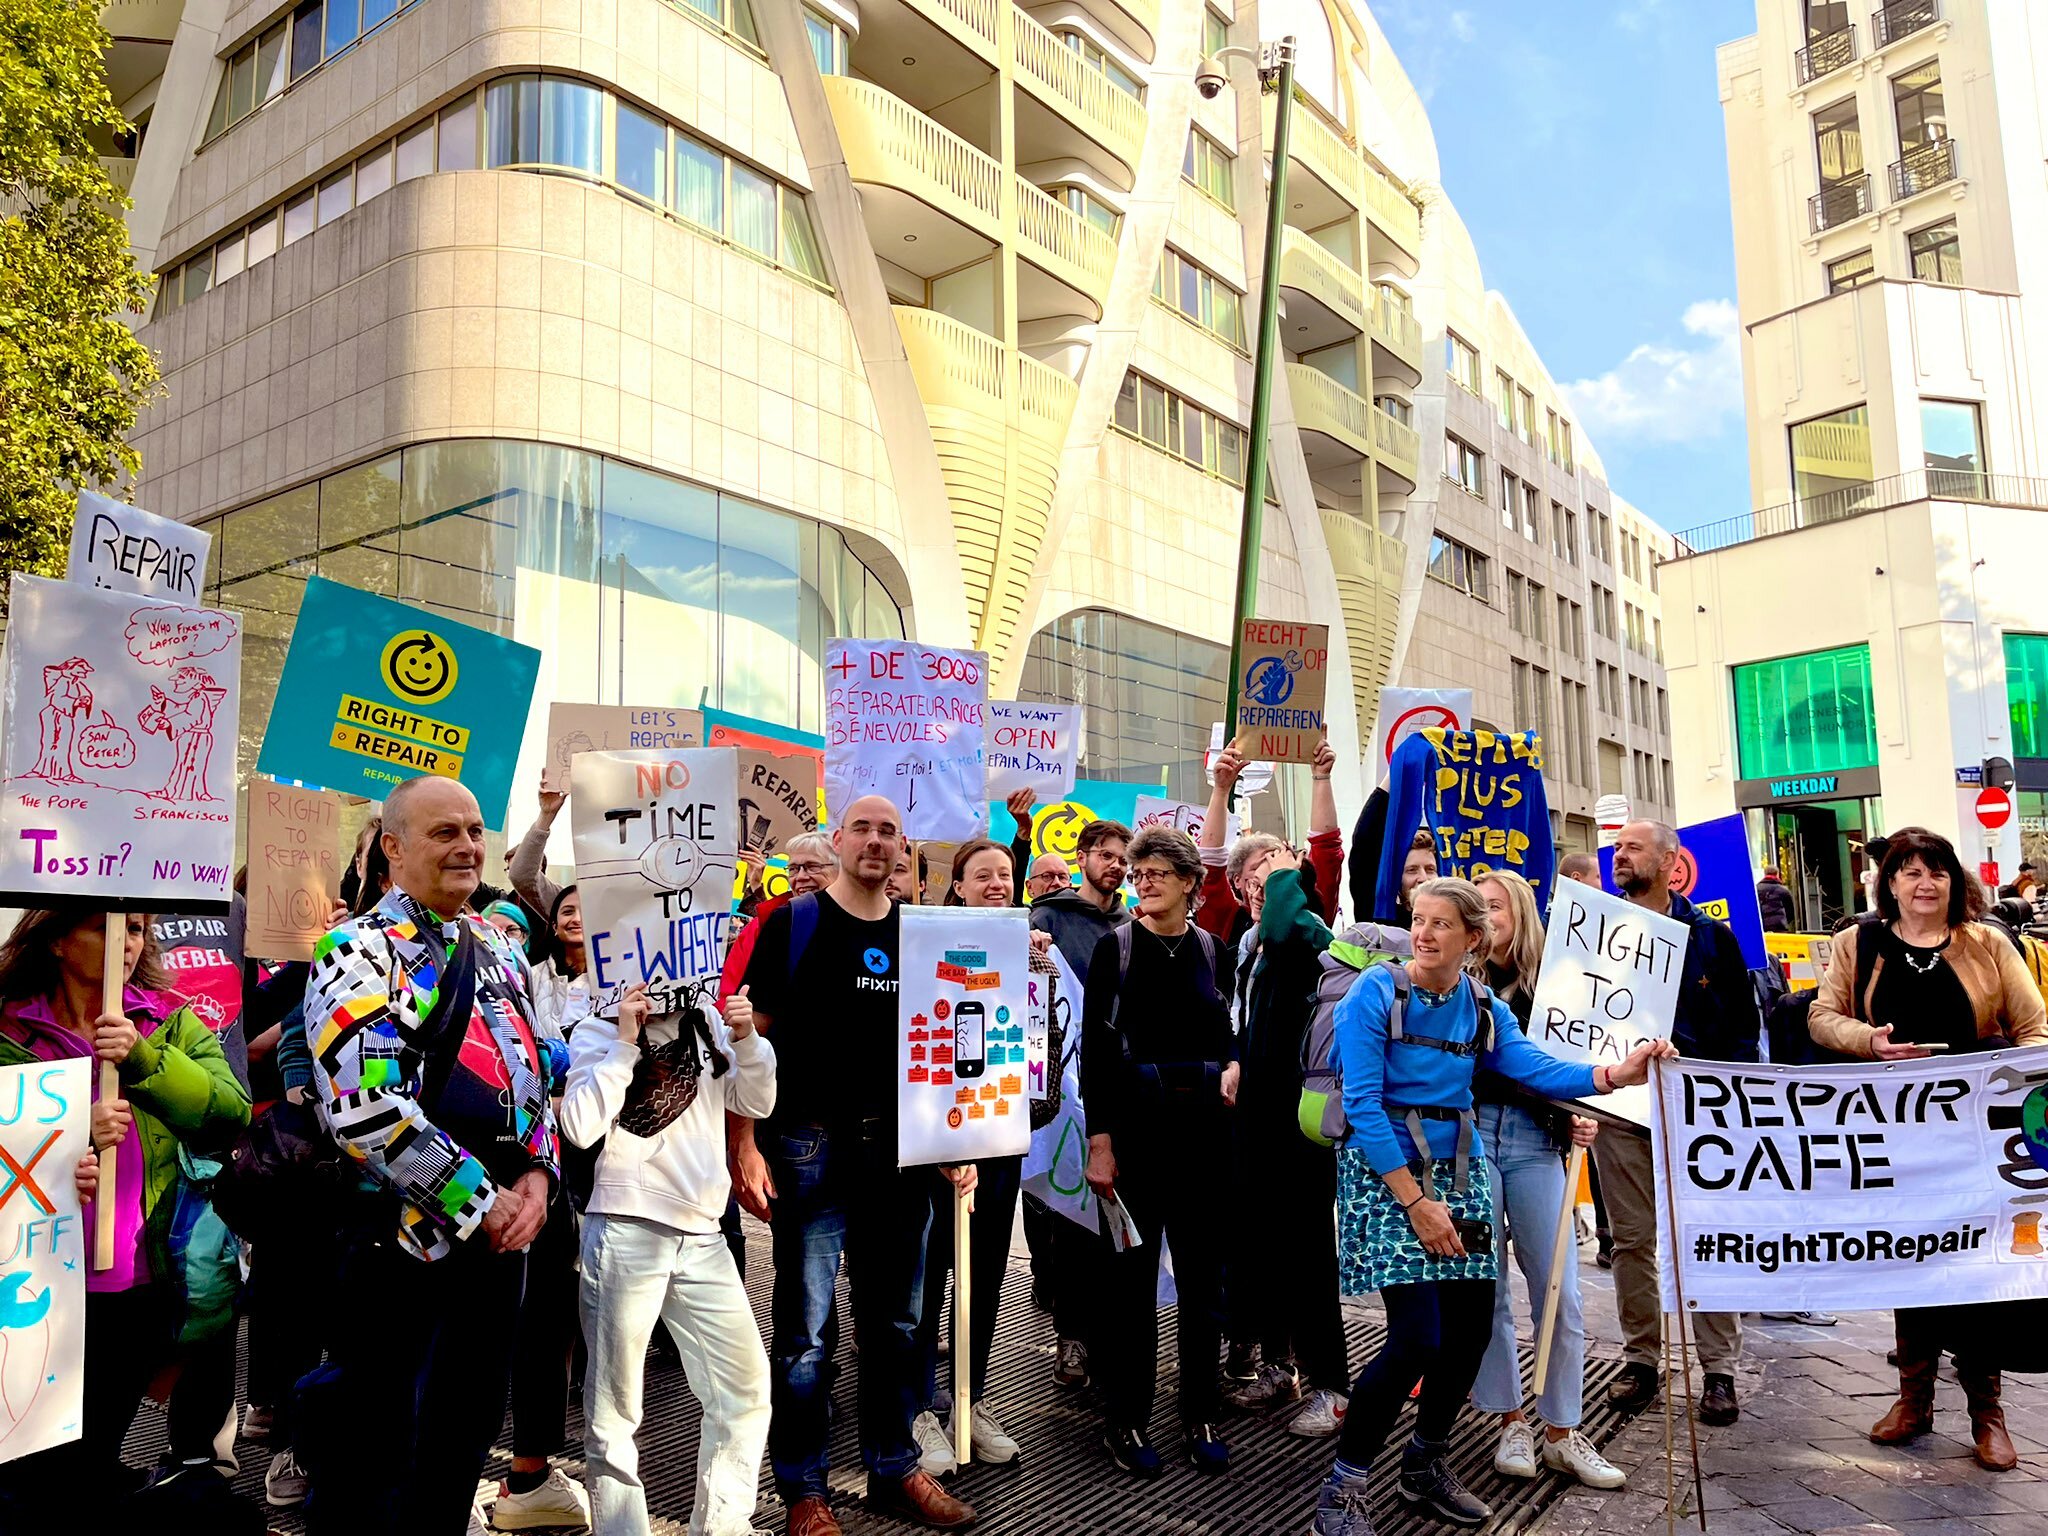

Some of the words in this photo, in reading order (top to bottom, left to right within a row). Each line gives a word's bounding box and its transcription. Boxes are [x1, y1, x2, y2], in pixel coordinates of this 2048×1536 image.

[147, 619, 171, 636] WHO
[177, 623, 205, 634] FIXES
[1245, 623, 1308, 647] RECHT
[871, 652, 904, 679] DE
[921, 652, 978, 685] 3000
[1304, 649, 1327, 670] OP
[347, 700, 422, 734] RIGHT
[431, 723, 460, 746] TO
[991, 706, 1012, 717] WE
[1020, 710, 1063, 722] WANT
[1240, 706, 1320, 730] REPAREREN
[87, 731, 110, 743] SAN
[832, 717, 947, 746] BÉNEVOLES
[994, 728, 1056, 749] OPEN
[86, 743, 127, 759] PETER!
[355, 733, 439, 770] REPAIR
[988, 753, 1020, 769] EPAIR
[636, 760, 690, 799] NO
[896, 763, 909, 775] ET
[752, 764, 817, 832] REPARER
[1435, 767, 1522, 820] PLUS
[1770, 777, 1837, 797] WEEKDAY
[18, 793, 40, 808] THE
[48, 795, 88, 809] POPE
[267, 792, 335, 825] RIGHT
[284, 827, 307, 843] TO
[1436, 826, 1529, 864] JETER
[264, 845, 335, 871] REPAIR
[153, 860, 180, 880] NO
[192, 864, 229, 892] WAY!
[654, 887, 693, 918] TO
[1701, 903, 1722, 917] TO
[151, 919, 228, 940] REPAIR
[1566, 900, 1678, 983] RIGHT
[160, 949, 233, 970] REBEL
[591, 912, 731, 988] E-WASTE
[857, 976, 899, 992] IFIXIT
[939, 968, 951, 976] THE
[952, 969, 966, 977] BAD
[967, 977, 978, 985] THE
[1583, 972, 1634, 1020] TO
[1028, 1016, 1045, 1029] ITH
[1028, 1037, 1043, 1050] HE
[1682, 1073, 1971, 1128] REPAIR
[1687, 1133, 1894, 1191] CAFE
[1693, 1224, 1987, 1273] #RightToRepair
